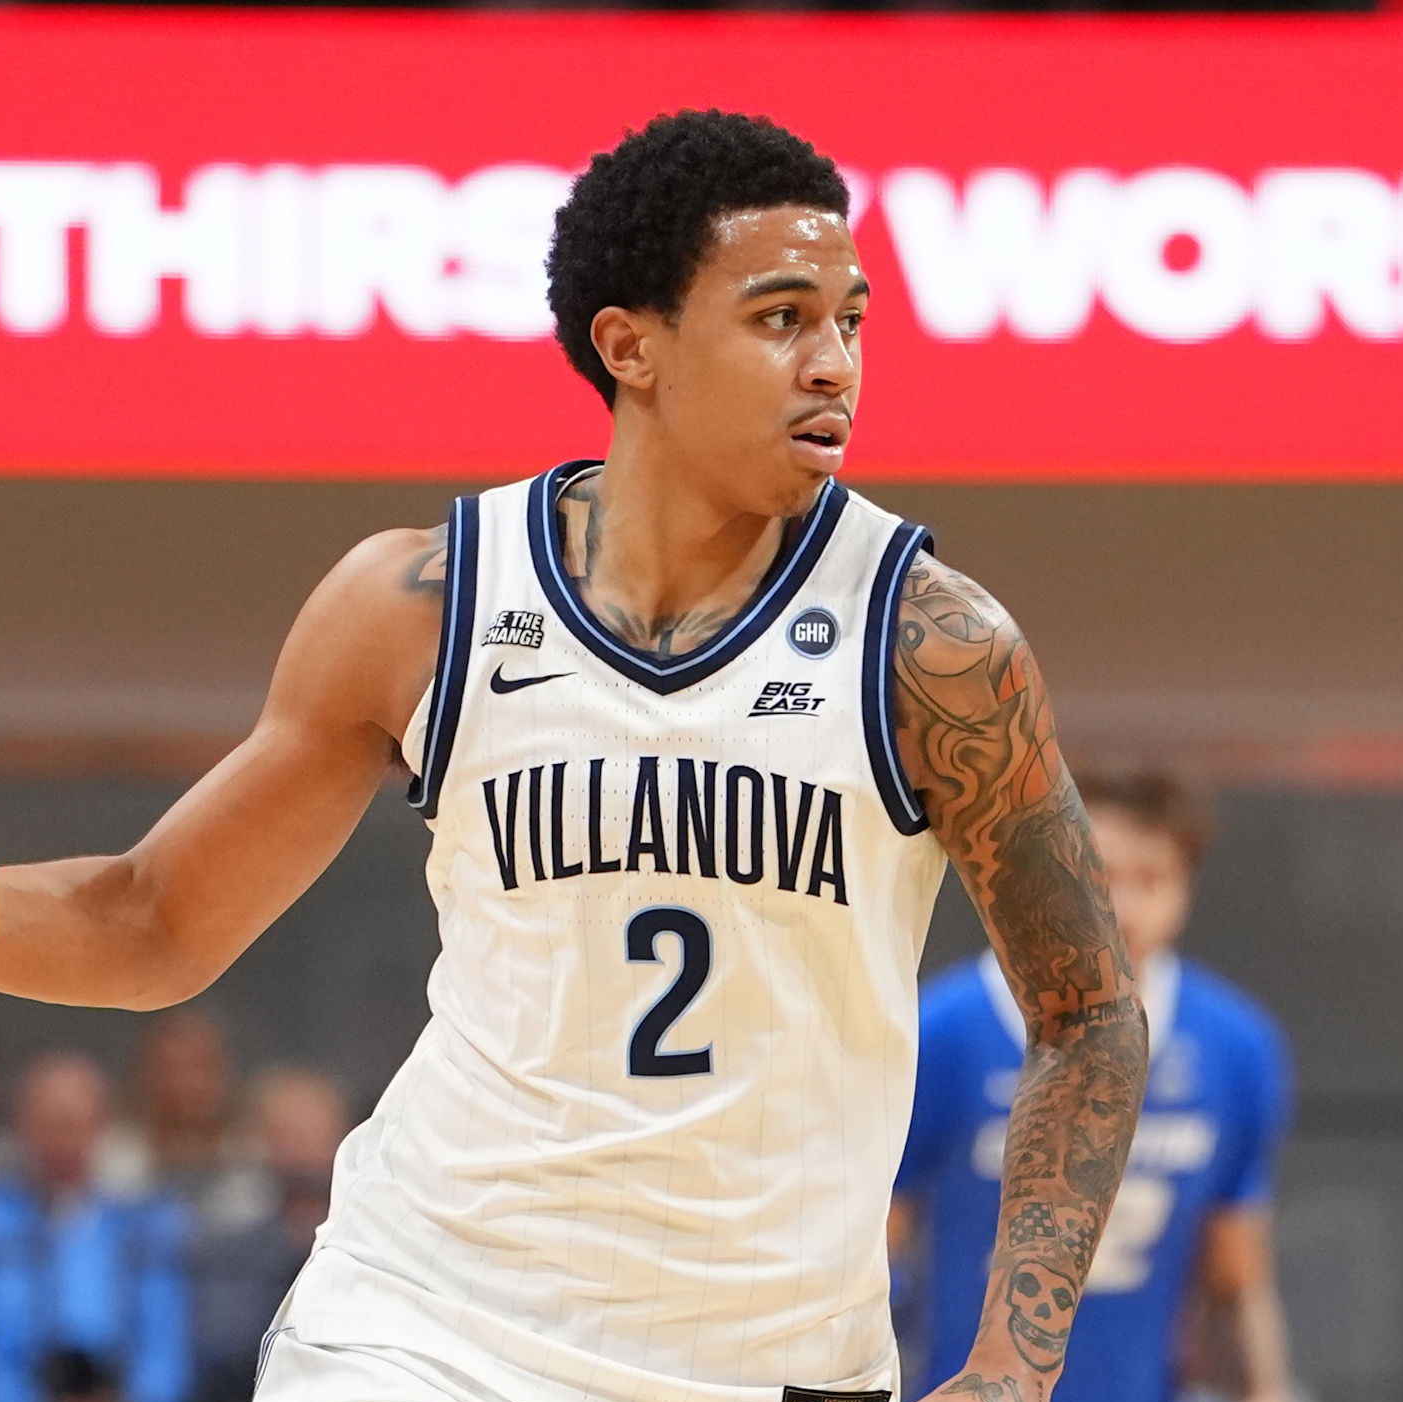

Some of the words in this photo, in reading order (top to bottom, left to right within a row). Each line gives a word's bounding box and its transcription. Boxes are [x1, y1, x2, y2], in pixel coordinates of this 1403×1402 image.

[510, 611, 543, 632] THE
[481, 627, 543, 648] HANGE
[794, 622, 830, 644] GHR
[761, 681, 813, 696] BIG
[752, 697, 826, 710] EAST
[482, 756, 850, 906] VILLANOVA
[624, 904, 713, 1078] 2
